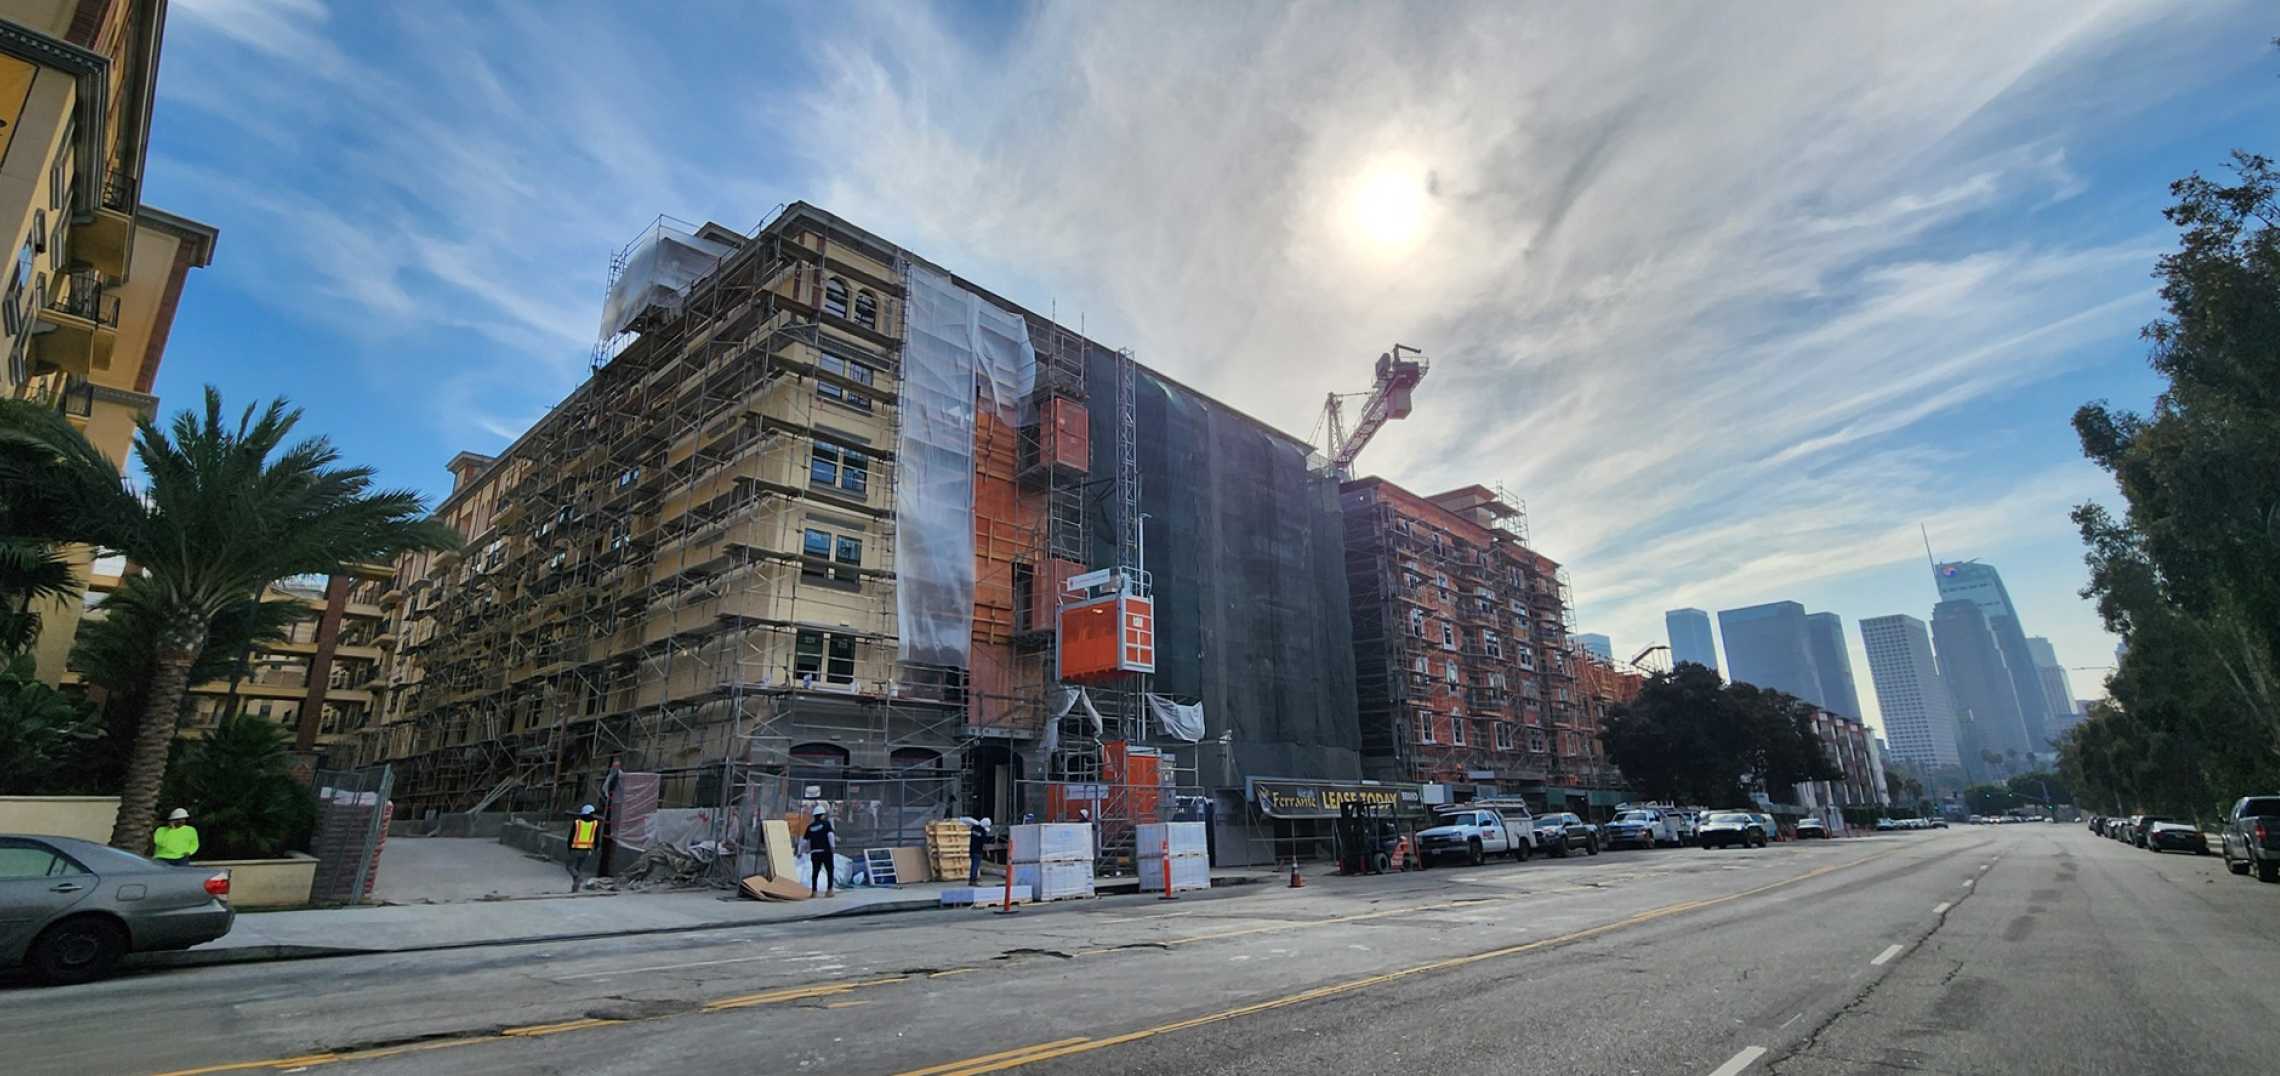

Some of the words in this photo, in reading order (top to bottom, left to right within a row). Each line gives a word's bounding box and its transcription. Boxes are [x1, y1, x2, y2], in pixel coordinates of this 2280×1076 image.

[1272, 791, 1317, 808] Ferrante
[1322, 791, 1358, 809] LEASE
[1359, 791, 1397, 809] TODAY
